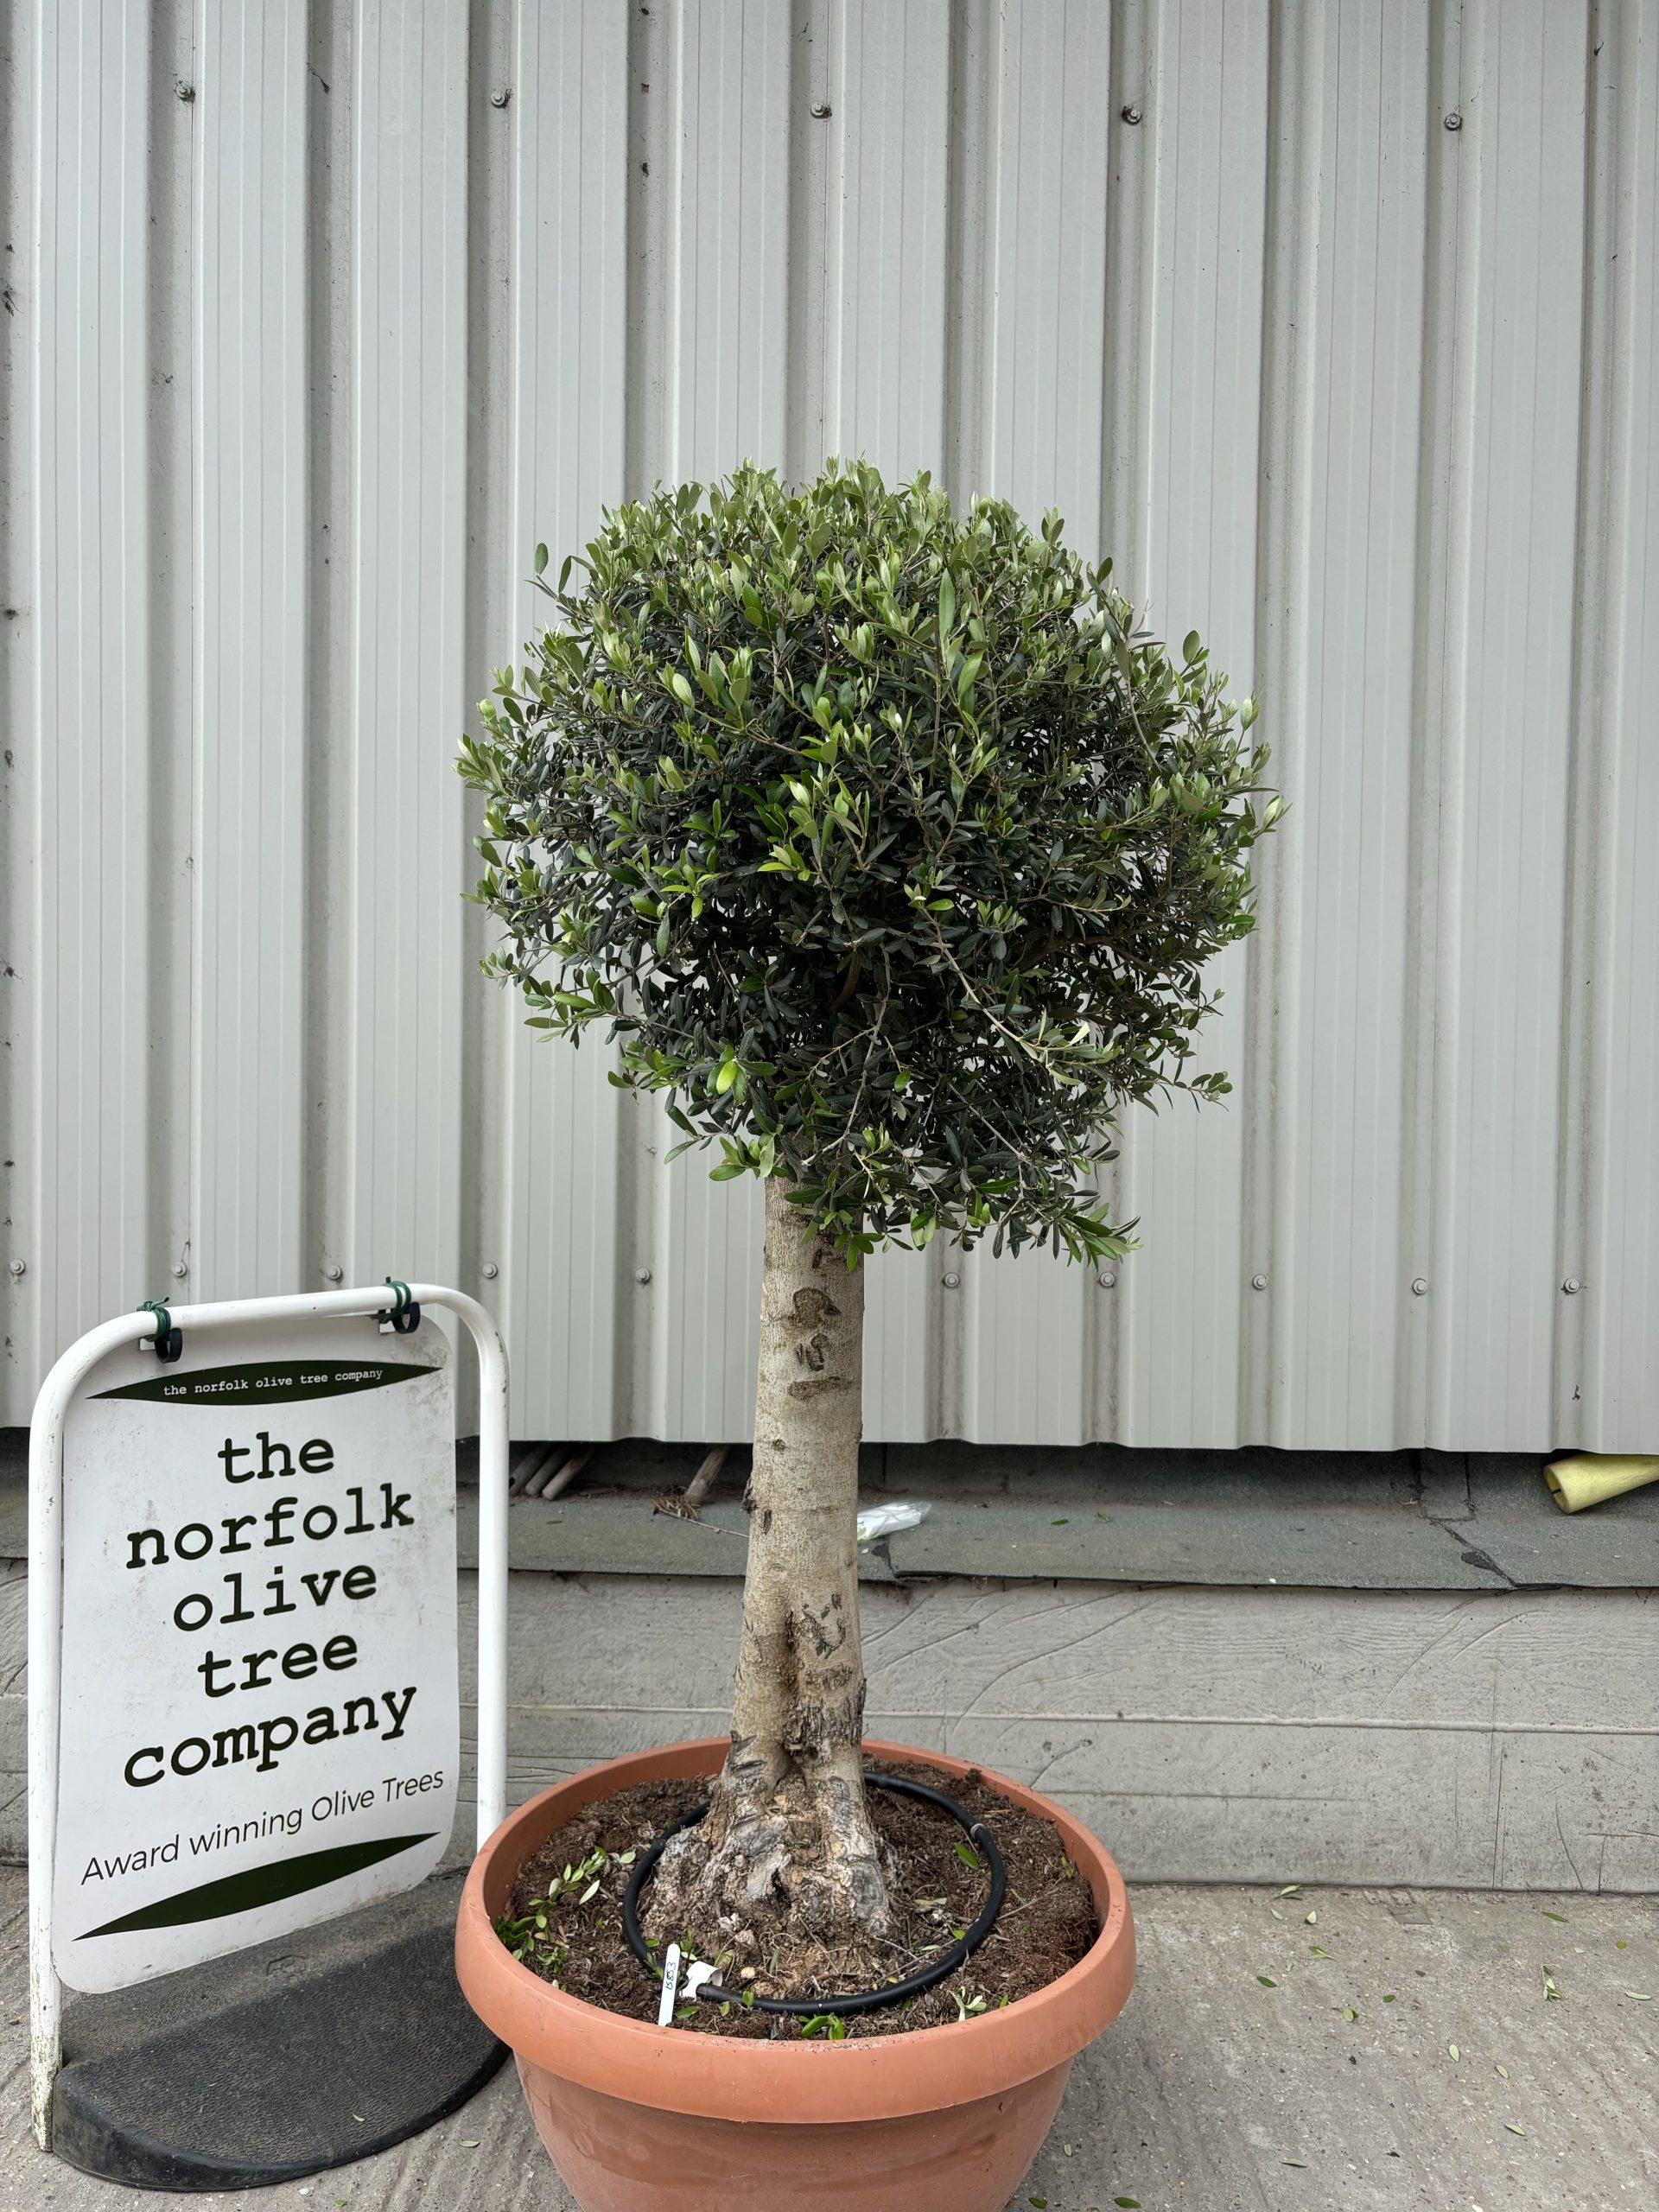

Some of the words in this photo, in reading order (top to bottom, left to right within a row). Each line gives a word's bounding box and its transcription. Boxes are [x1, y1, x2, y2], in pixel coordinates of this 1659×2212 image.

[163, 1384, 188, 1396] the
[194, 1379, 249, 1394] norfolk
[255, 1376, 293, 1389] olive
[300, 1374, 328, 1384] tree
[334, 1369, 384, 1382] company
[218, 1432, 334, 1484] the
[126, 1483, 415, 1569] norfolk
[174, 1565, 377, 1632] olive
[198, 1634, 358, 1698] tree
[124, 1687, 417, 1788] company
[80, 1834, 180, 1885] Award
[189, 1808, 302, 1855] winning
[311, 1790, 375, 1821] Olive
[382, 1770, 443, 1802] Trees
